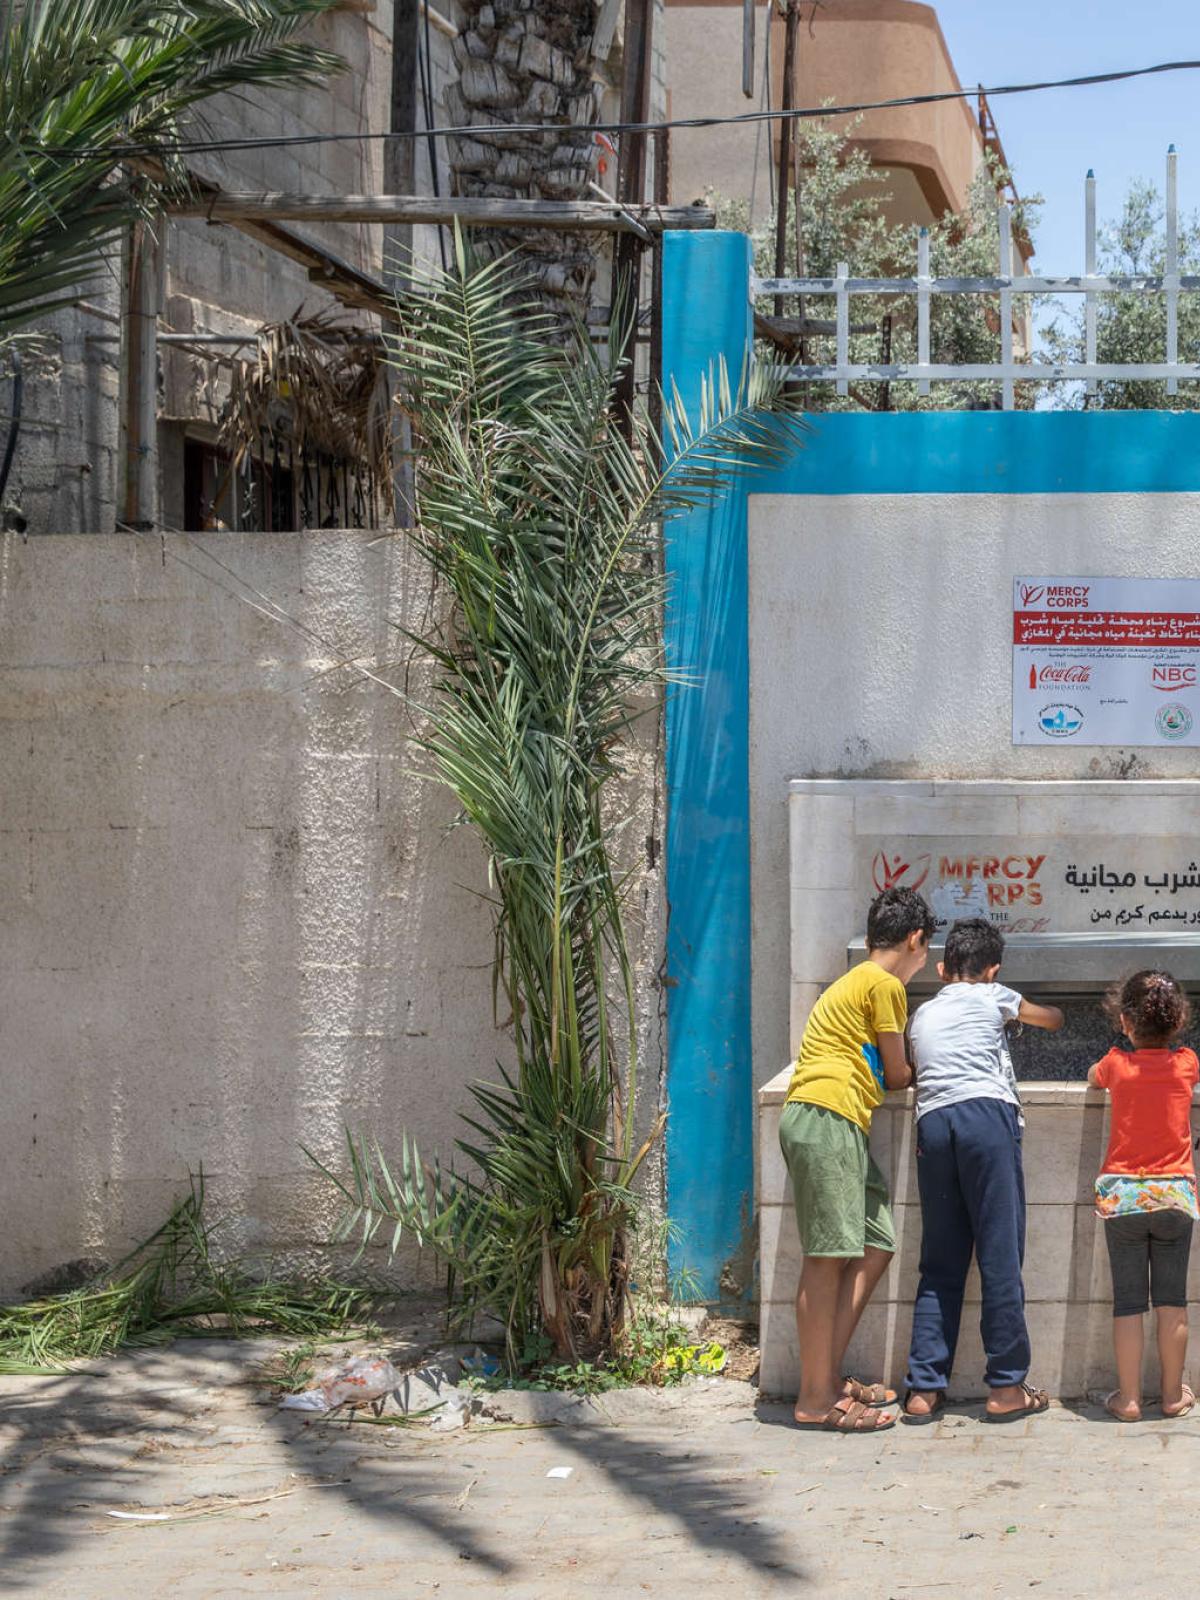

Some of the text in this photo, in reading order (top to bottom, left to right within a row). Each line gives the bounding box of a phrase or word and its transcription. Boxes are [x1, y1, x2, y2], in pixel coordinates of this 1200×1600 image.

[1047, 586, 1090, 597] MERCY
[1047, 597, 1089, 608] CORPS
[1020, 612, 1048, 628] شرب
[1051, 616, 1075, 628] مياه
[1108, 614, 1144, 626] محطة
[1145, 616, 1167, 629] بناء
[1055, 626, 1065, 643] في
[1068, 626, 1103, 641] مجانية
[1104, 630, 1125, 641] مياه
[1127, 627, 1155, 641] تعبئة
[1152, 667, 1197, 681] NBC
[939, 854, 1047, 880] MERCY
[1065, 864, 1136, 894] مجانية
[989, 912, 1009, 921] THE
[1090, 907, 1112, 923] من
[1148, 909, 1187, 924] بدعم
